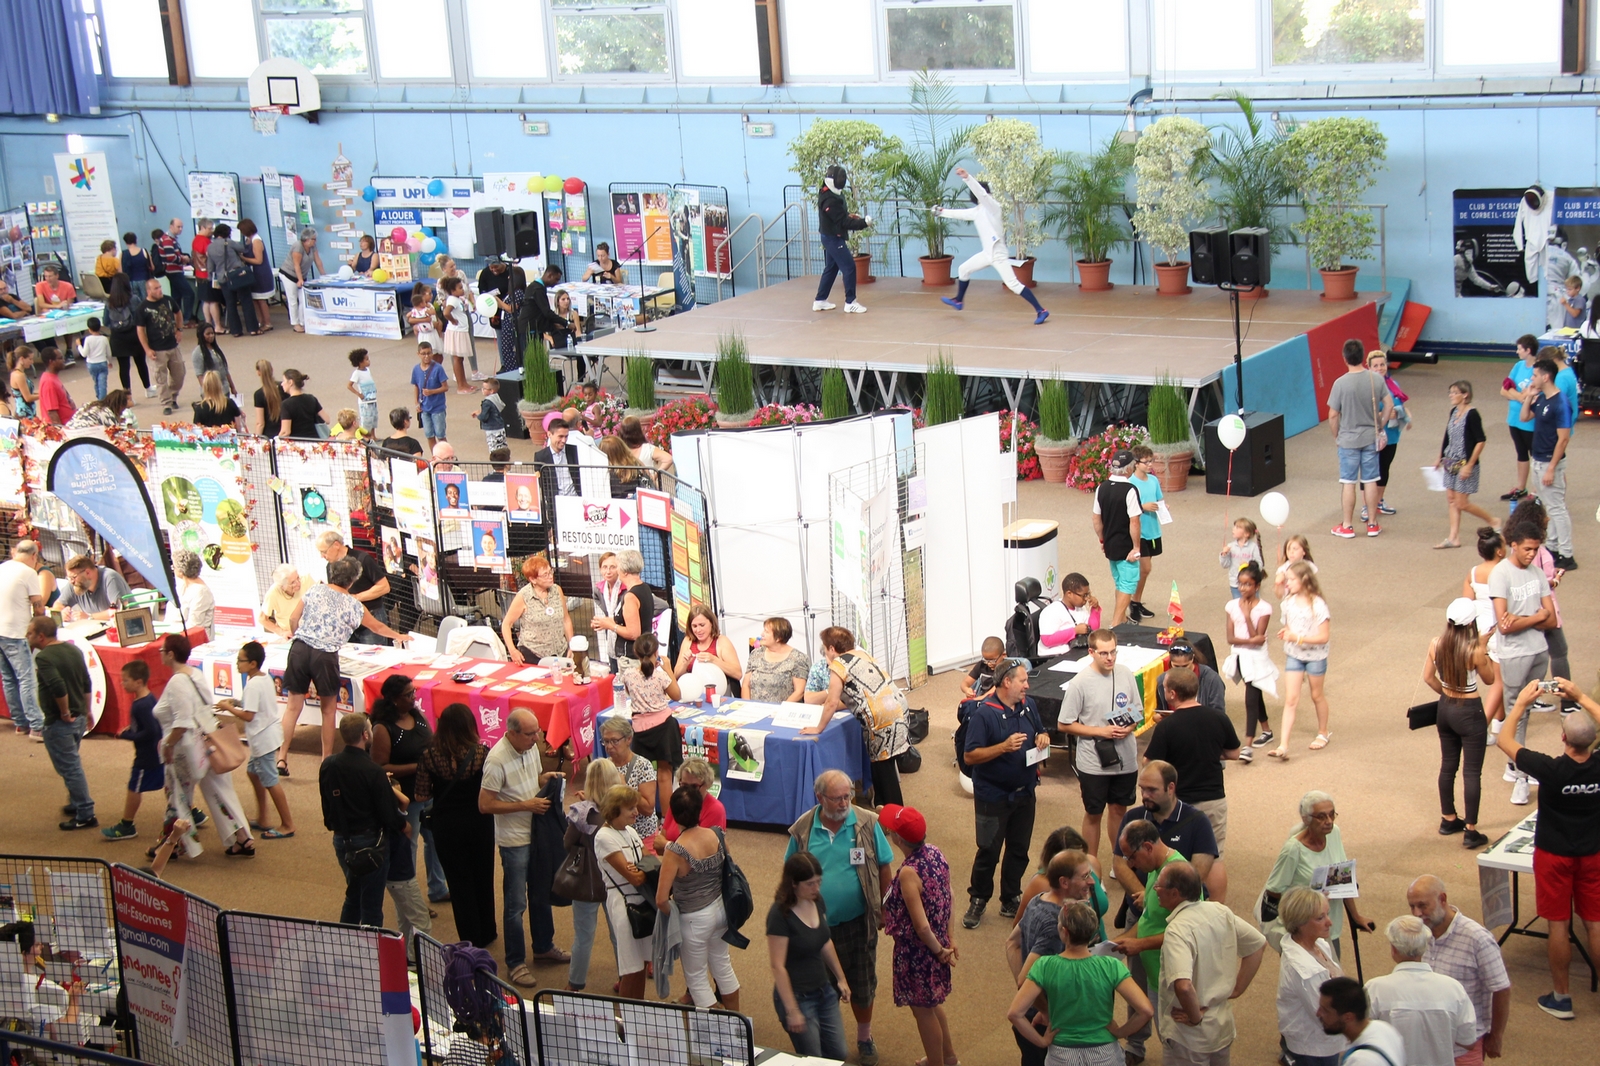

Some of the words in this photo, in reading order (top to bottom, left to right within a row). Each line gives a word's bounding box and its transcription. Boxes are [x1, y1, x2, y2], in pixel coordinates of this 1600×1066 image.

[403, 188, 425, 198] UNPI
[381, 212, 387, 220] A
[388, 211, 414, 220] LOUER
[1565, 210, 1600, 218] CORBEIL-
[332, 297, 348, 306] UNPI
[562, 531, 592, 544] RESTOS
[595, 533, 606, 544] DU
[608, 534, 635, 546] COEUR
[682, 744, 710, 755] parler
[114, 876, 170, 912] Initiatives
[122, 955, 171, 988] andonnée
[162, 1000, 176, 1015] Esso
